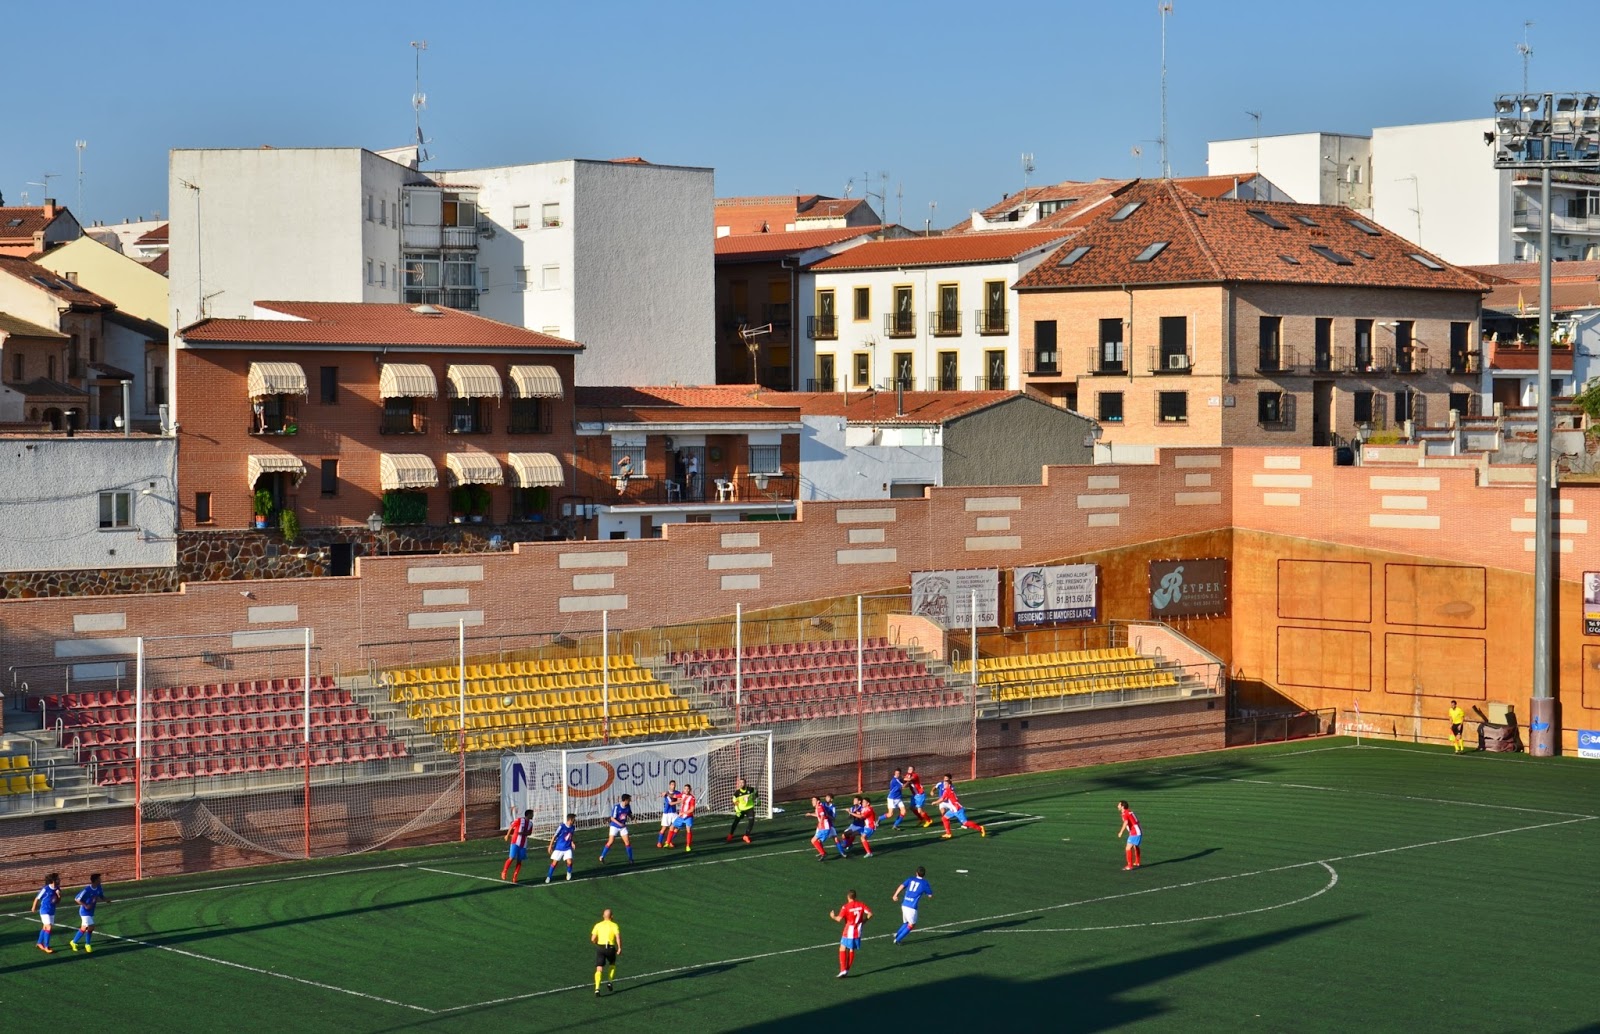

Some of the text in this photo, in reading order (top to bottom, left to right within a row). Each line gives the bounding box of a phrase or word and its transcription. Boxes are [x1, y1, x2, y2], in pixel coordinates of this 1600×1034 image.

[1056, 594, 1092, 604] 91.813.60.05
[956, 614, 994, 623] 91.81.15.60
[1018, 609, 1091, 622] RESIDENCIA DE MAYORES LA PAZ
[908, 881, 920, 892] 11
[854, 910, 861, 924] 7
